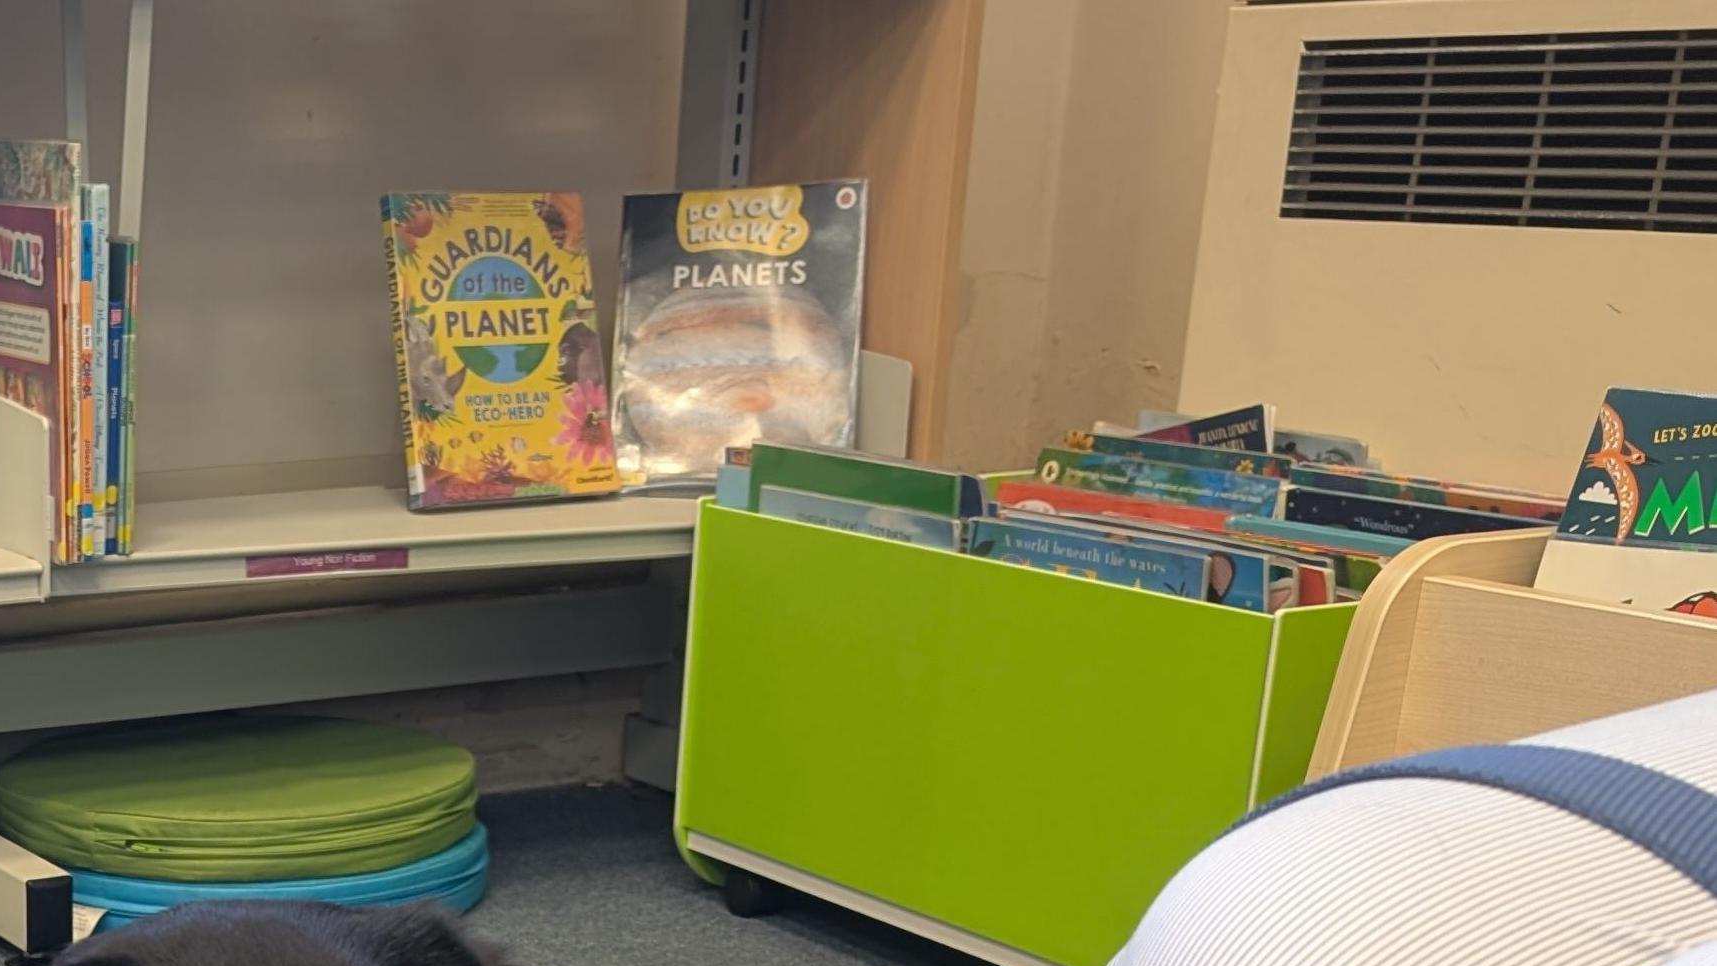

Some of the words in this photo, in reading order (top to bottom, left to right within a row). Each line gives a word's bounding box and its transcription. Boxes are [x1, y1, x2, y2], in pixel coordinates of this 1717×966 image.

[686, 199, 719, 222] DO
[728, 193, 792, 220] YOU
[687, 221, 802, 250] KNOW?
[420, 226, 570, 302] GUARDIANS
[673, 259, 808, 289] PLANETS
[384, 236, 404, 335] GUARDIANS
[463, 273, 487, 293] of
[493, 272, 526, 293] the
[445, 308, 549, 338] PLANET
[465, 392, 496, 406] HOW
[499, 391, 513, 405] TO
[518, 391, 533, 405] BE
[534, 390, 550, 404] AN
[474, 406, 545, 423] ECO-HERO
[1653, 426, 1687, 444] LET'S
[293, 556, 323, 566] Young
[345, 553, 376, 563] Fiction
[1002, 534, 1013, 548] A
[1015, 537, 1050, 553] world
[1052, 541, 1101, 563] beneath
[1104, 549, 1125, 568] the
[1128, 558, 1166, 575] waves
